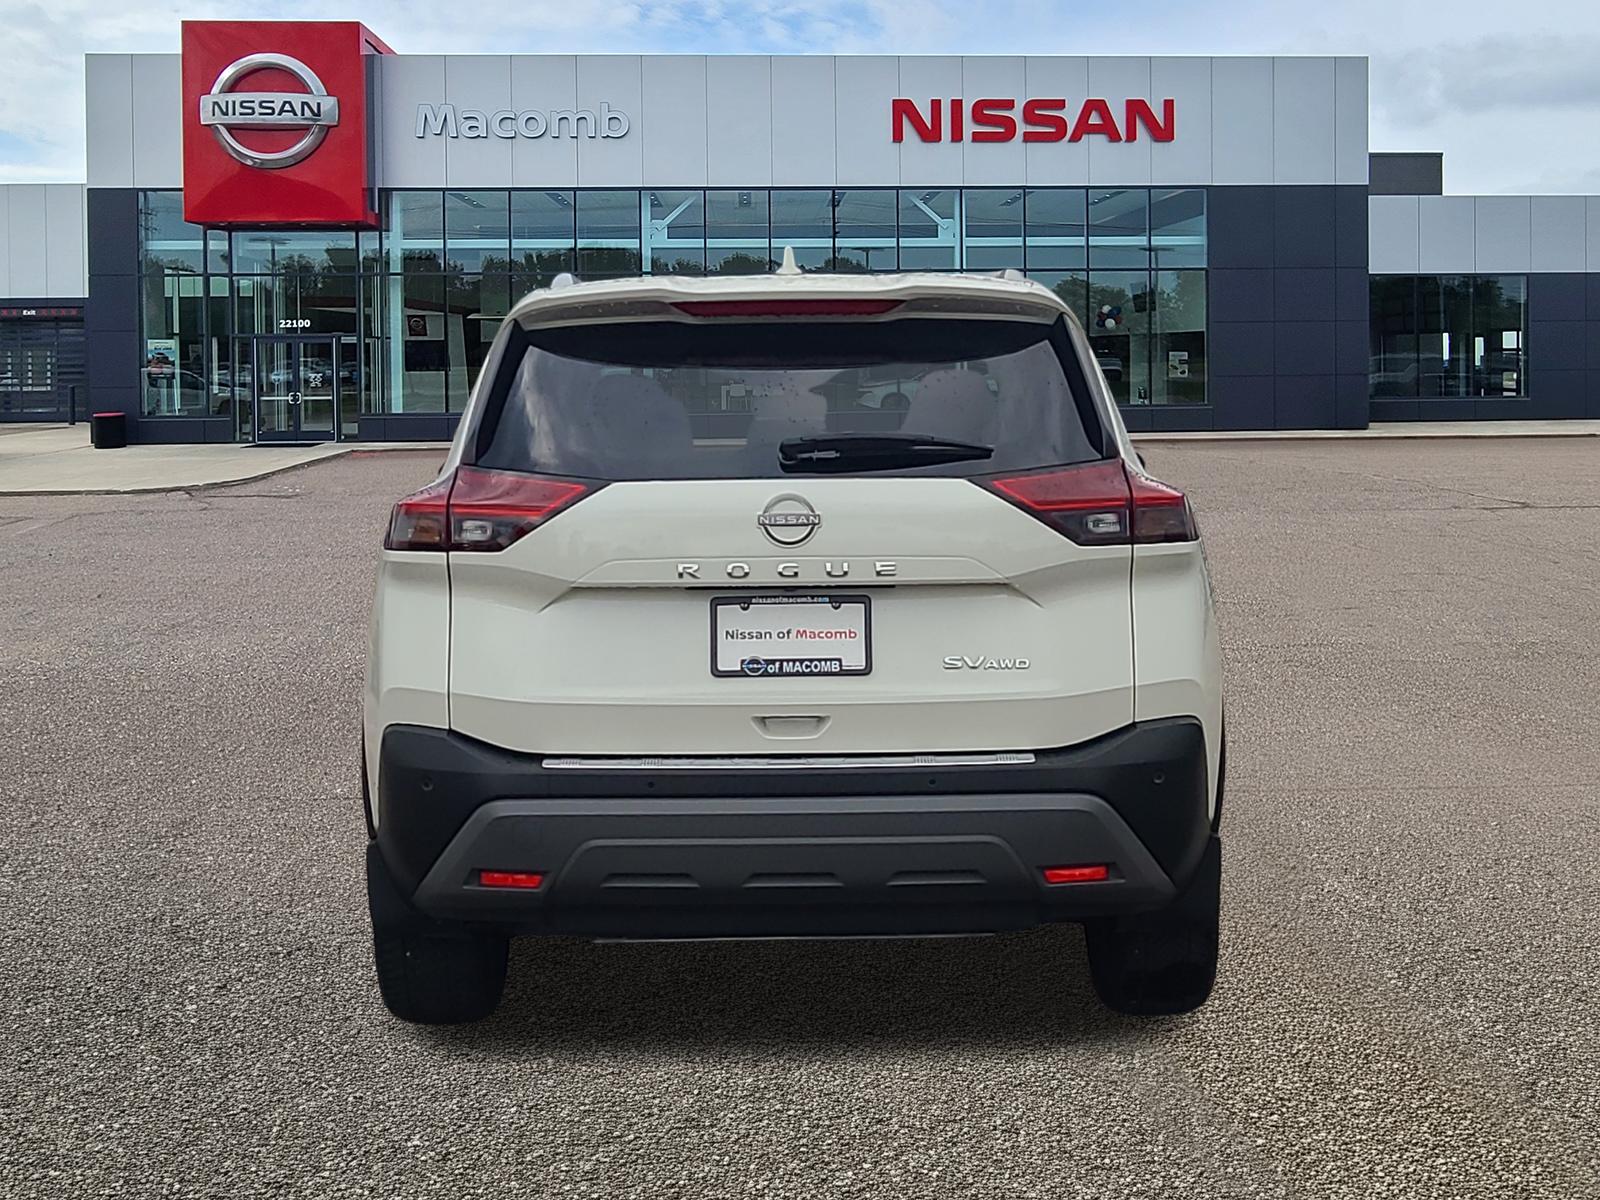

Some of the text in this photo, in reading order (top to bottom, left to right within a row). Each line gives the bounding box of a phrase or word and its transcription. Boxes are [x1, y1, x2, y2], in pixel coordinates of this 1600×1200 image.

[211, 98, 322, 119] NISSAN
[415, 102, 630, 139] Macomb
[892, 98, 1175, 143] NISSAN
[22, 309, 37, 317] Exit
[279, 319, 311, 328] 22100
[759, 515, 820, 525] NISSAN
[725, 629, 857, 640] Nissan of Macomb
[767, 661, 780, 673] of
[782, 661, 840, 673] MACOMB
